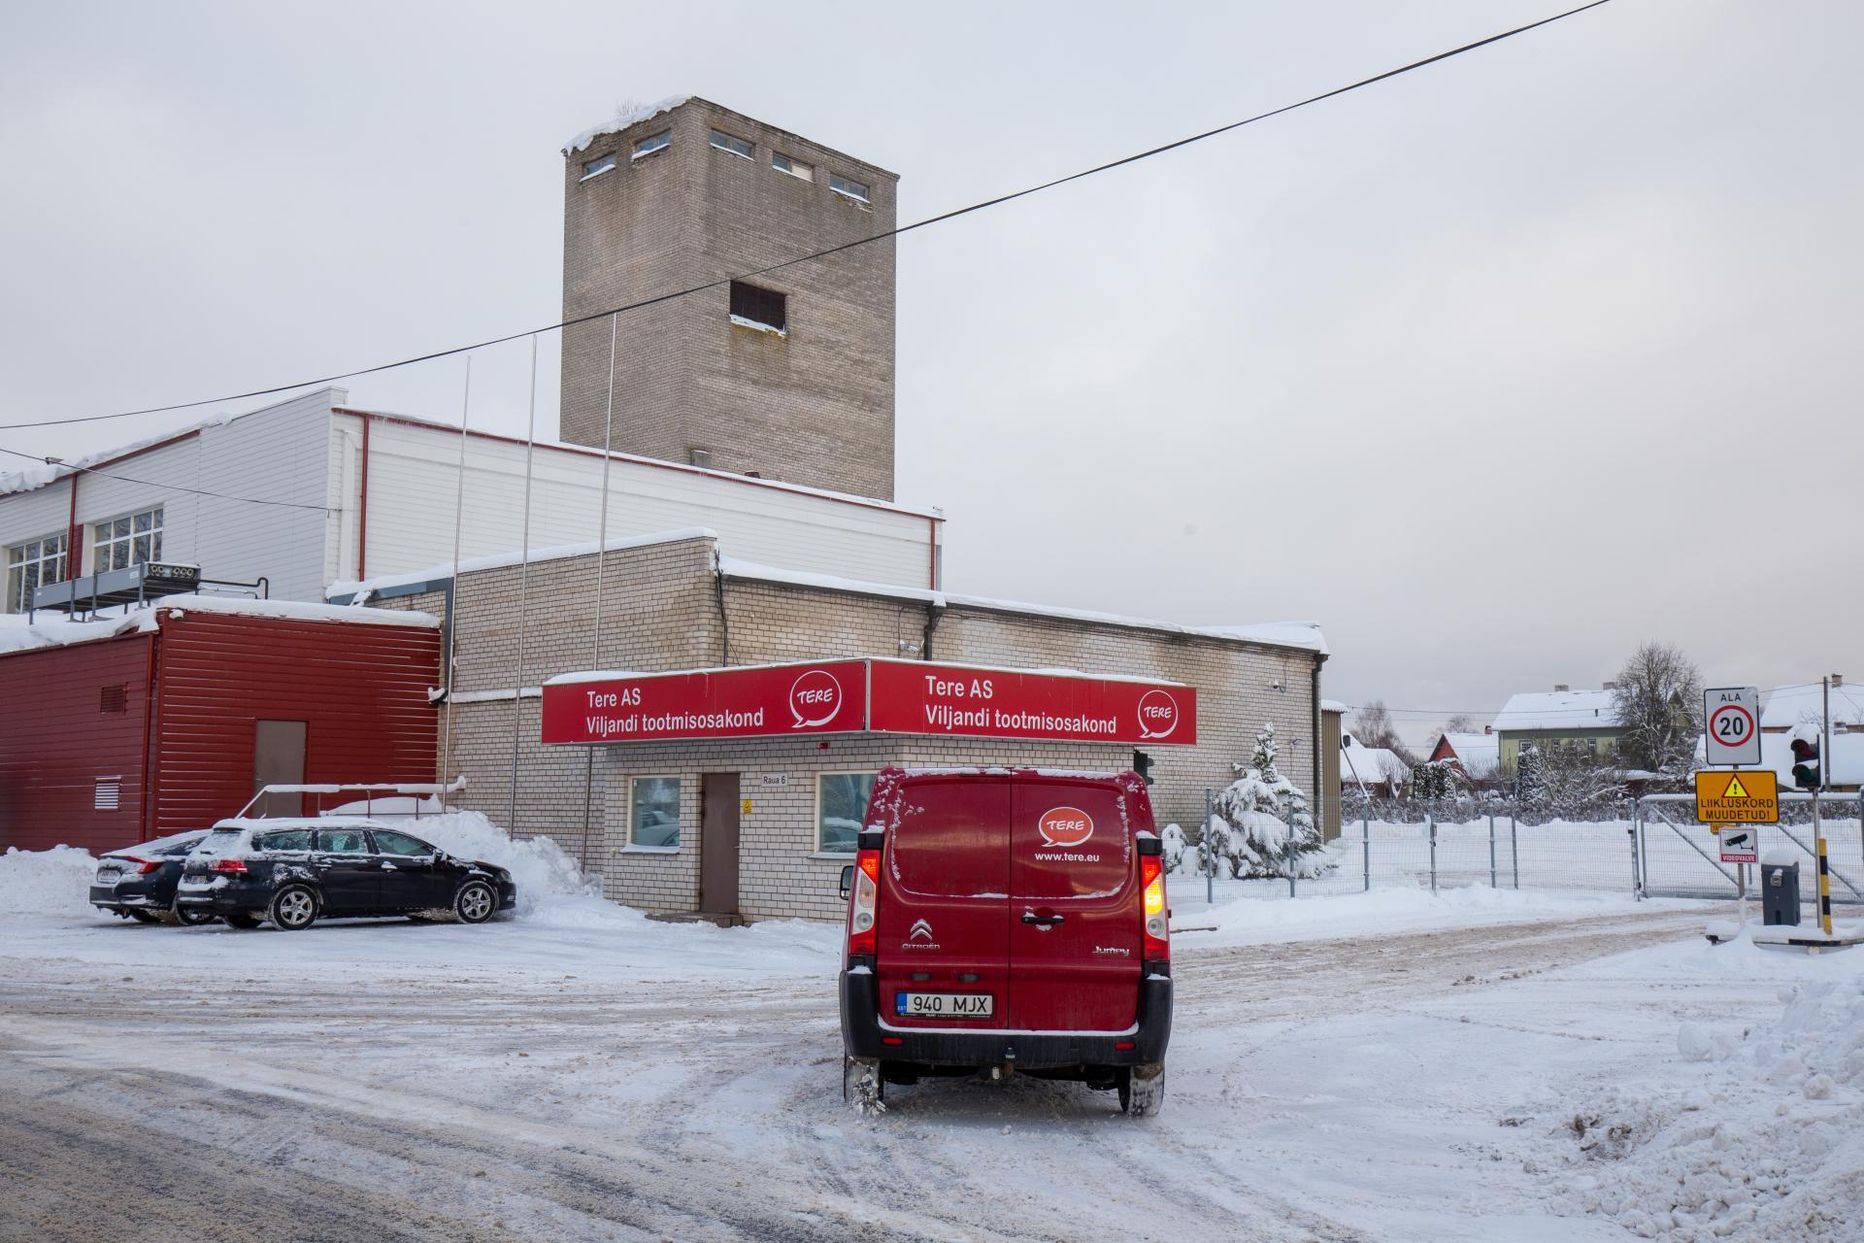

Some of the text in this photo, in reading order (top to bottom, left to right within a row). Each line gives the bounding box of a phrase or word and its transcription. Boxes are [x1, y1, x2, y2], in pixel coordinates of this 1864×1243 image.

[925, 675, 993, 699] Tere AS
[586, 687, 641, 708] Tere AS
[797, 688, 833, 705] TERE
[1720, 693, 1742, 702] ALA
[1143, 706, 1172, 719] TERE
[586, 707, 764, 738] Viljandi tootmisosakond
[925, 704, 1117, 734] Viljandi tootmisosakond
[1719, 716, 1744, 736] 20
[763, 775, 786, 784] Raua 6
[1700, 798, 1774, 808] LIIKLUSKORD
[1705, 810, 1770, 820] MUUDETUD!
[1046, 820, 1085, 831] TERE
[1034, 852, 1100, 862] www.tere.eu
[1722, 854, 1756, 862] VIDEOVALVE
[1091, 945, 1130, 957] Jumpy
[913, 996, 988, 1013] 940 MJX
